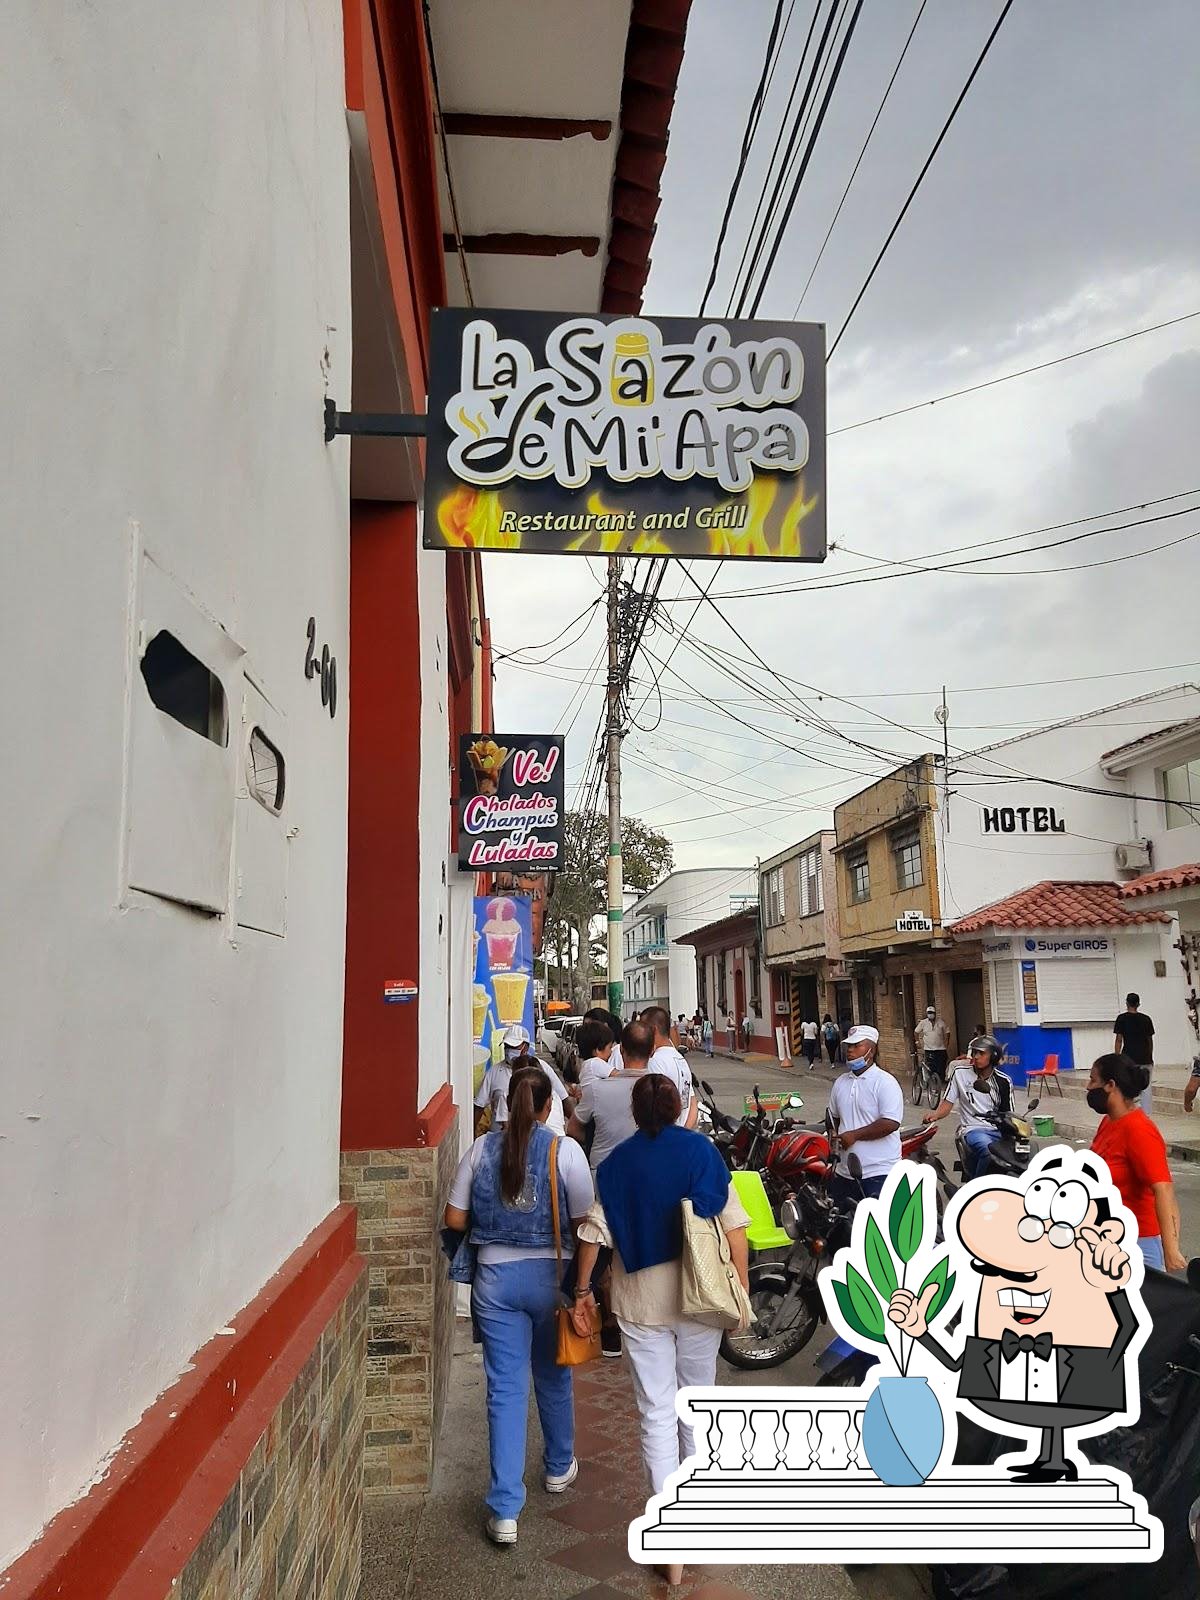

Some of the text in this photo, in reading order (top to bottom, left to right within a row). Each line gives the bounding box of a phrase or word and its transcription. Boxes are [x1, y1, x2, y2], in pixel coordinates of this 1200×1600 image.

[472, 327, 793, 406] La Sazón
[460, 382, 553, 473] de
[675, 408, 796, 483] Apa
[499, 504, 748, 533] Restaurant and Grill
[514, 747, 558, 785] Ve!
[465, 792, 556, 822] Cholados
[465, 806, 557, 832] Champus
[982, 807, 1066, 833] HOTEL
[470, 838, 557, 865] Luladas
[512, 829, 524, 846] y
[899, 919, 931, 931] HOTEL
